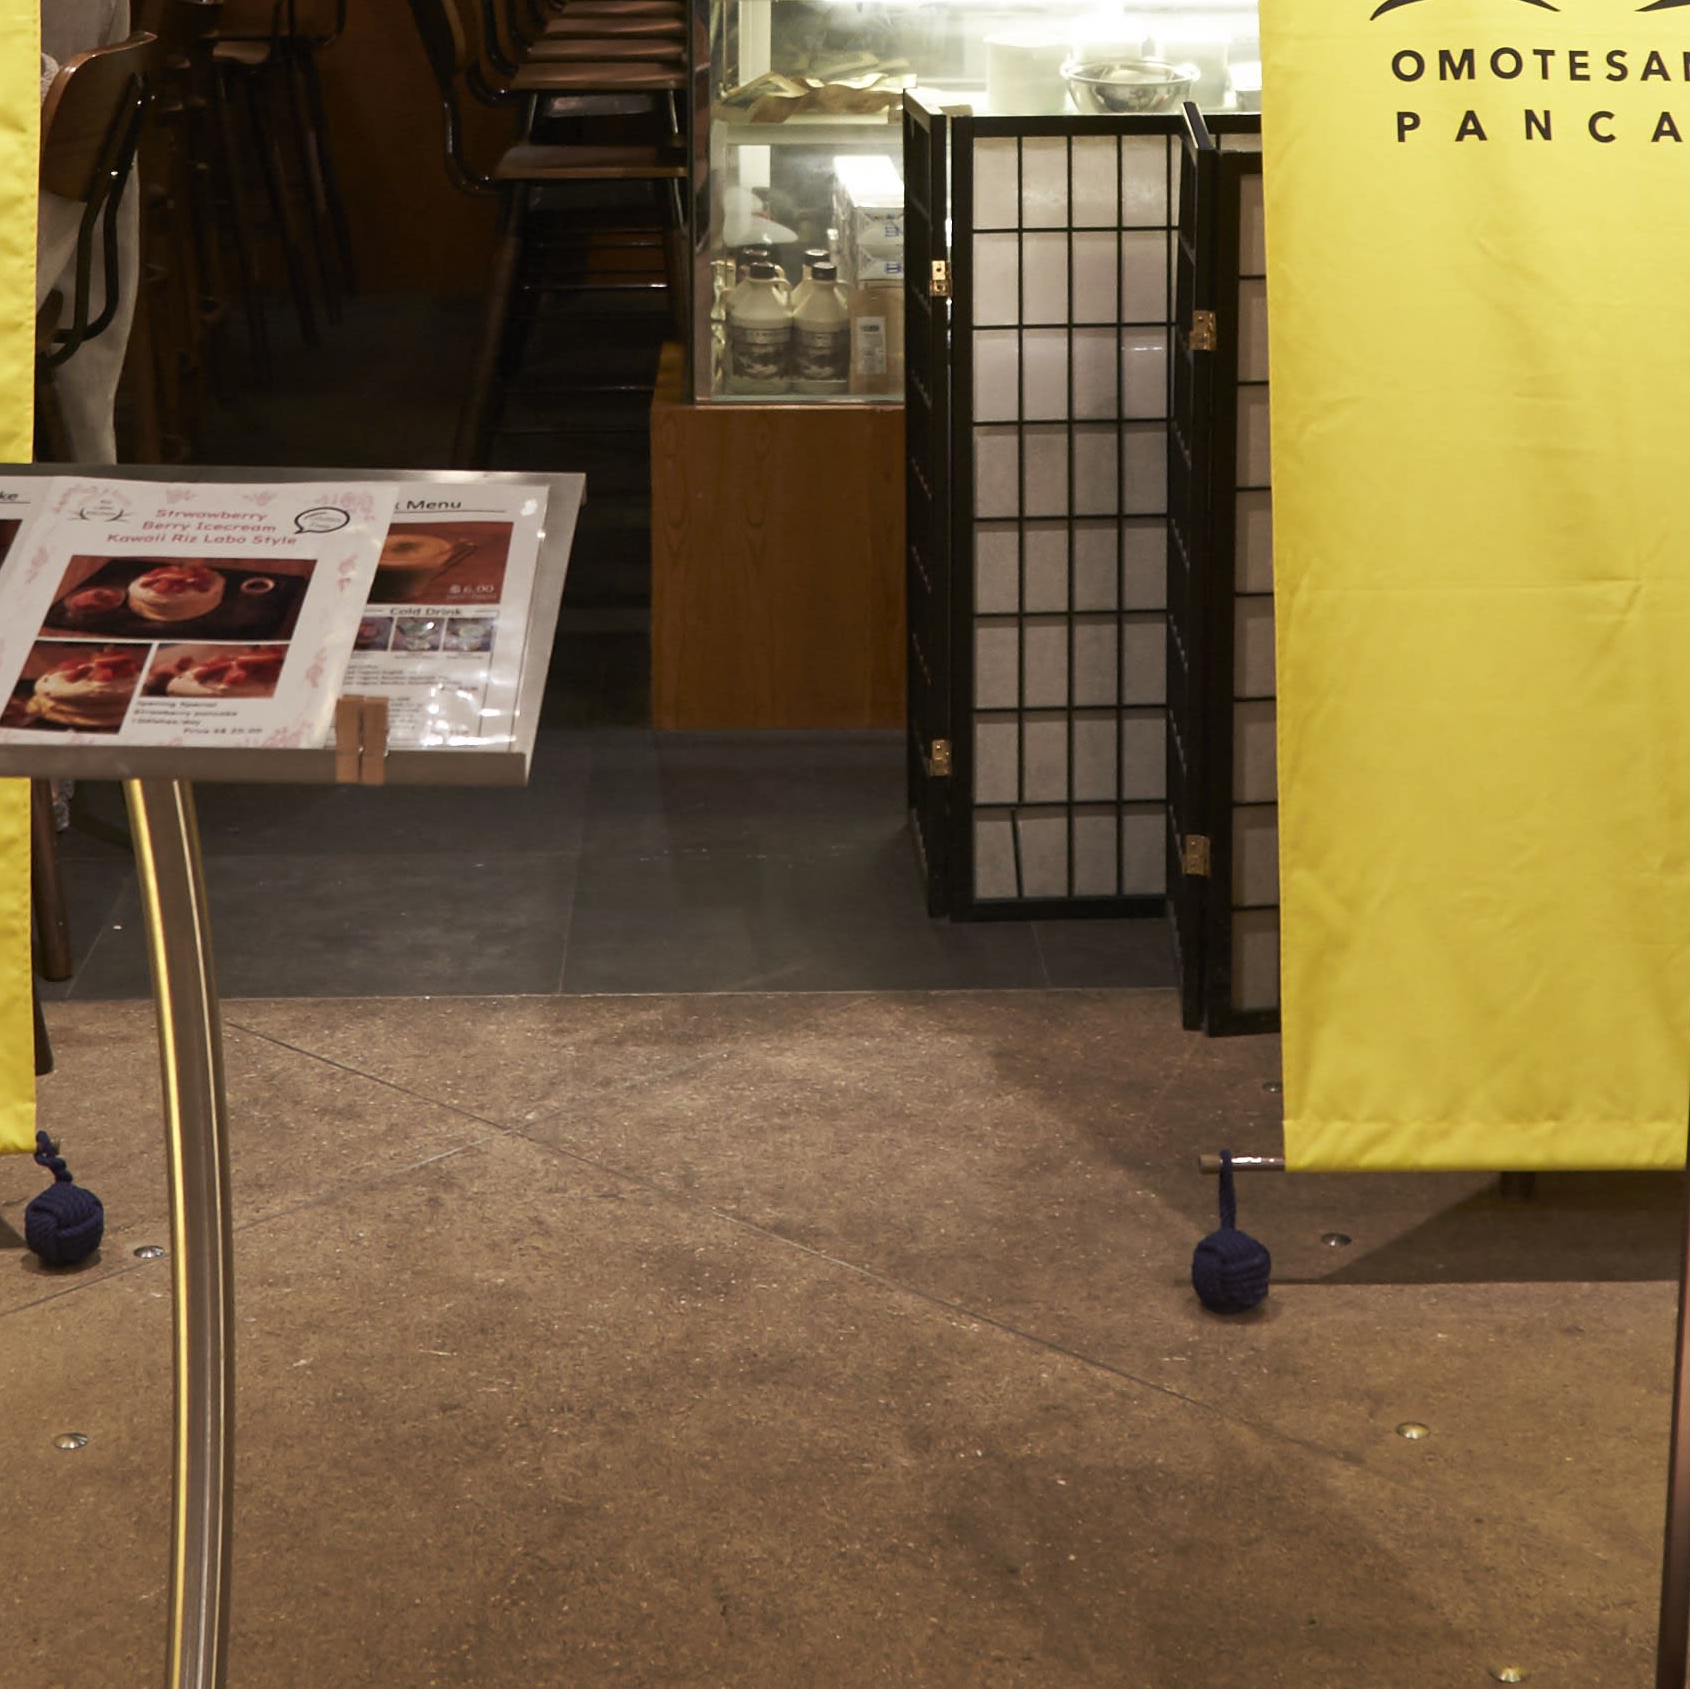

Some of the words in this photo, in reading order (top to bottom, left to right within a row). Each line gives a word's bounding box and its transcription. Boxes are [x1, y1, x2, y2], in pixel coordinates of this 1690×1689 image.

[406, 500, 463, 511] Menu
[142, 521, 191, 533] Berry
[196, 521, 277, 533] Icecream
[105, 533, 166, 544] Kawaii
[170, 533, 198, 544] Riz
[202, 533, 247, 545] Labo
[251, 534, 298, 546] Style
